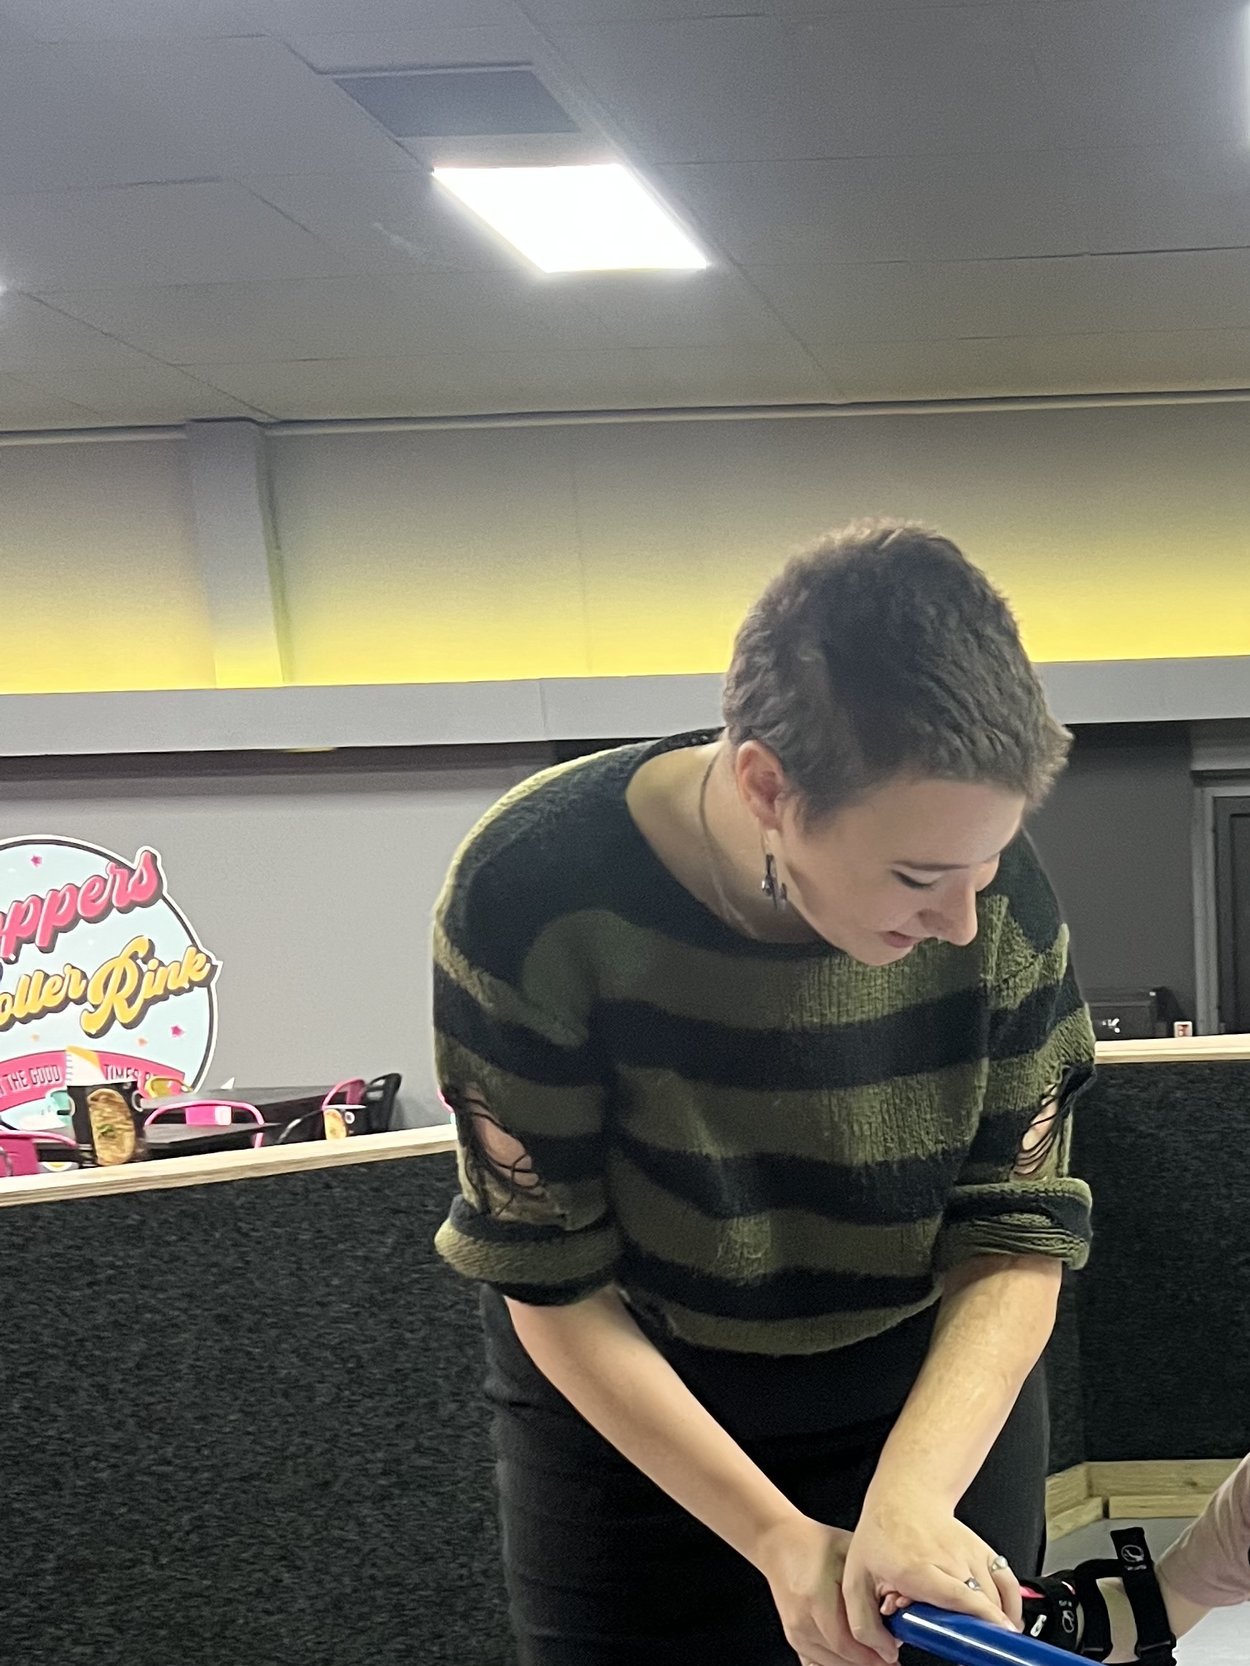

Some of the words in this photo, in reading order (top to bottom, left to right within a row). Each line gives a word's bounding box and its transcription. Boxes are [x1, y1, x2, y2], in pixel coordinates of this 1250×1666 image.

[0, 850, 160, 962] ppers
[0, 963, 88, 1032] oller
[80, 935, 217, 1038] Rink
[2, 1070, 30, 1091] THE
[28, 1064, 61, 1086] GOOD
